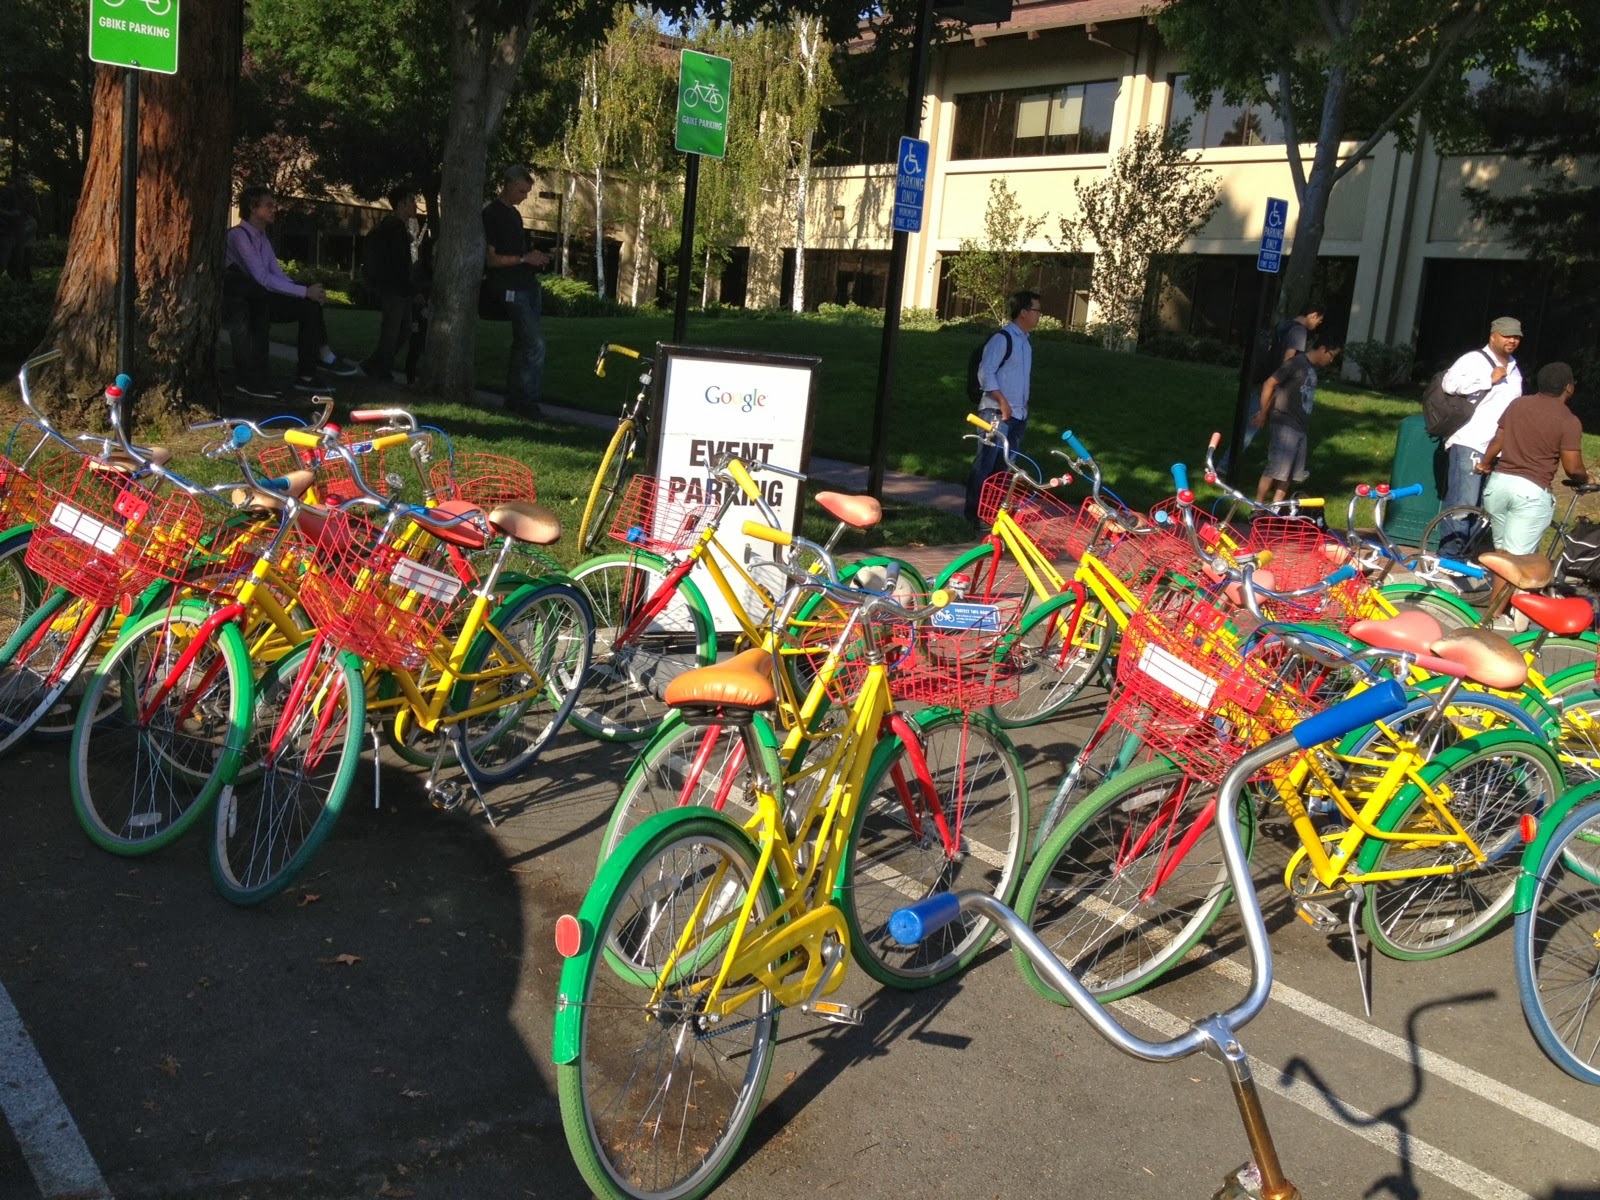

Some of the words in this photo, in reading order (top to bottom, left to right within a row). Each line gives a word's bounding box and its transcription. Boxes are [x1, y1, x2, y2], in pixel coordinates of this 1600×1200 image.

[99, 16, 126, 31] GBIKE
[129, 22, 170, 38] PARKING
[682, 115, 698, 126] GBIKE
[698, 118, 723, 131] PARKING
[898, 174, 924, 191] PARKING
[901, 189, 918, 205] ONLY
[906, 218, 919, 229] $250
[1263, 226, 1284, 239] PARKING
[705, 385, 767, 413] Google
[690, 439, 774, 468] EVENT
